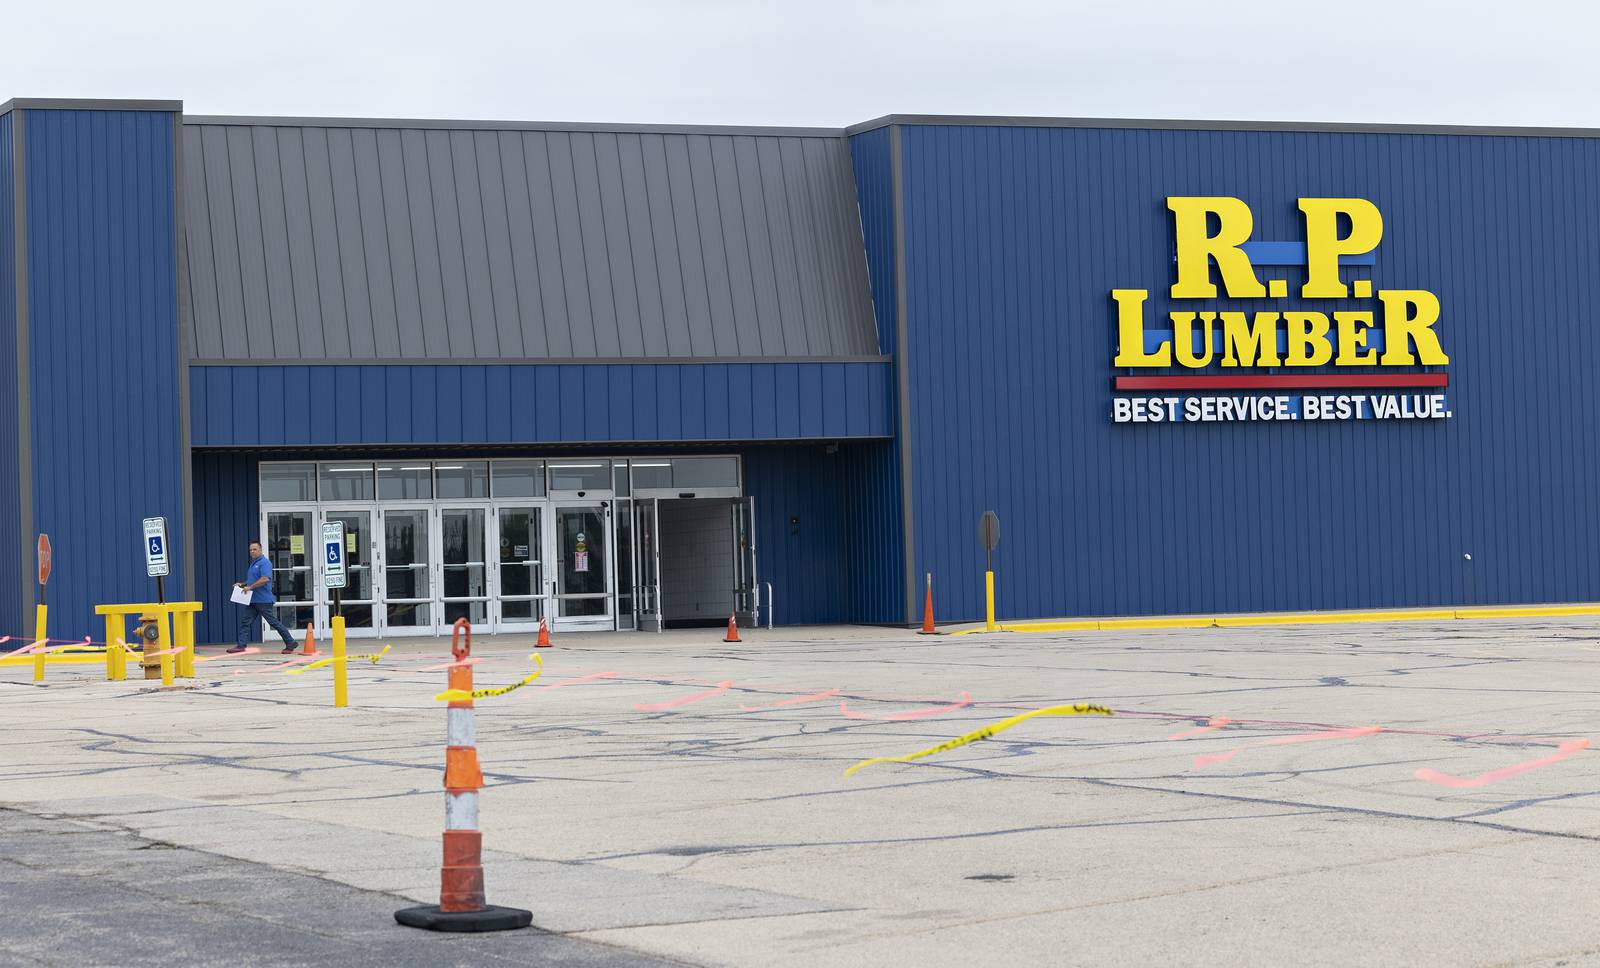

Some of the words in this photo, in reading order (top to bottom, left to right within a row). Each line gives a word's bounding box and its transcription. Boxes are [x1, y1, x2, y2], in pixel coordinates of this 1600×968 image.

[1166, 197, 1384, 299] R.P.
[1112, 289, 1449, 368] LUMBER
[1113, 397, 1179, 422] BEST
[1184, 396, 1297, 421] SERVICE.
[1303, 396, 1366, 420] BEST
[1370, 395, 1452, 418] VALUE.
